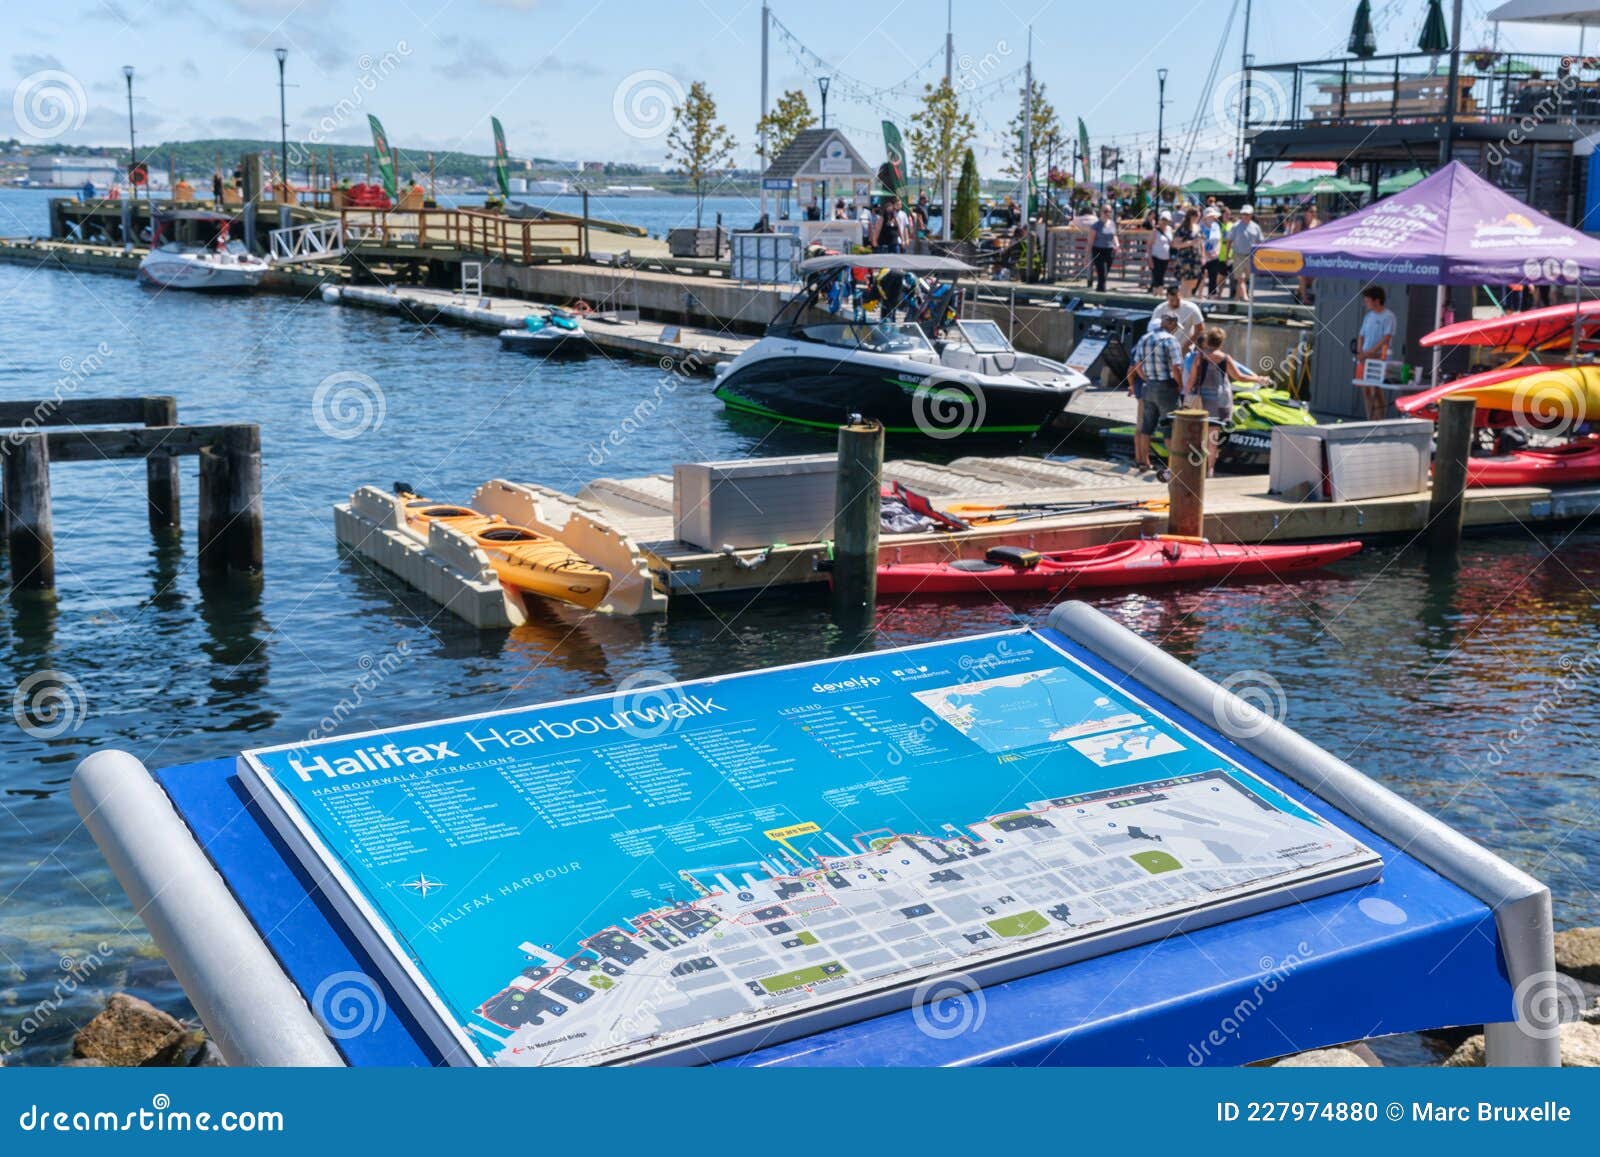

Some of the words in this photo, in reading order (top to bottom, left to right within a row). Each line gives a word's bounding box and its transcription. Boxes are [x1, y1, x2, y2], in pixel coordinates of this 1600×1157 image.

[811, 675, 880, 693] develop
[778, 703, 822, 716] LEGEND
[289, 741, 461, 782] Halifax
[464, 694, 728, 753] Harbourwalk
[312, 773, 419, 796] HARBOURWALK
[425, 756, 515, 777] ATTRACTIONS
[428, 893, 495, 933] HALIFAX
[498, 861, 583, 896] HARBOUR
